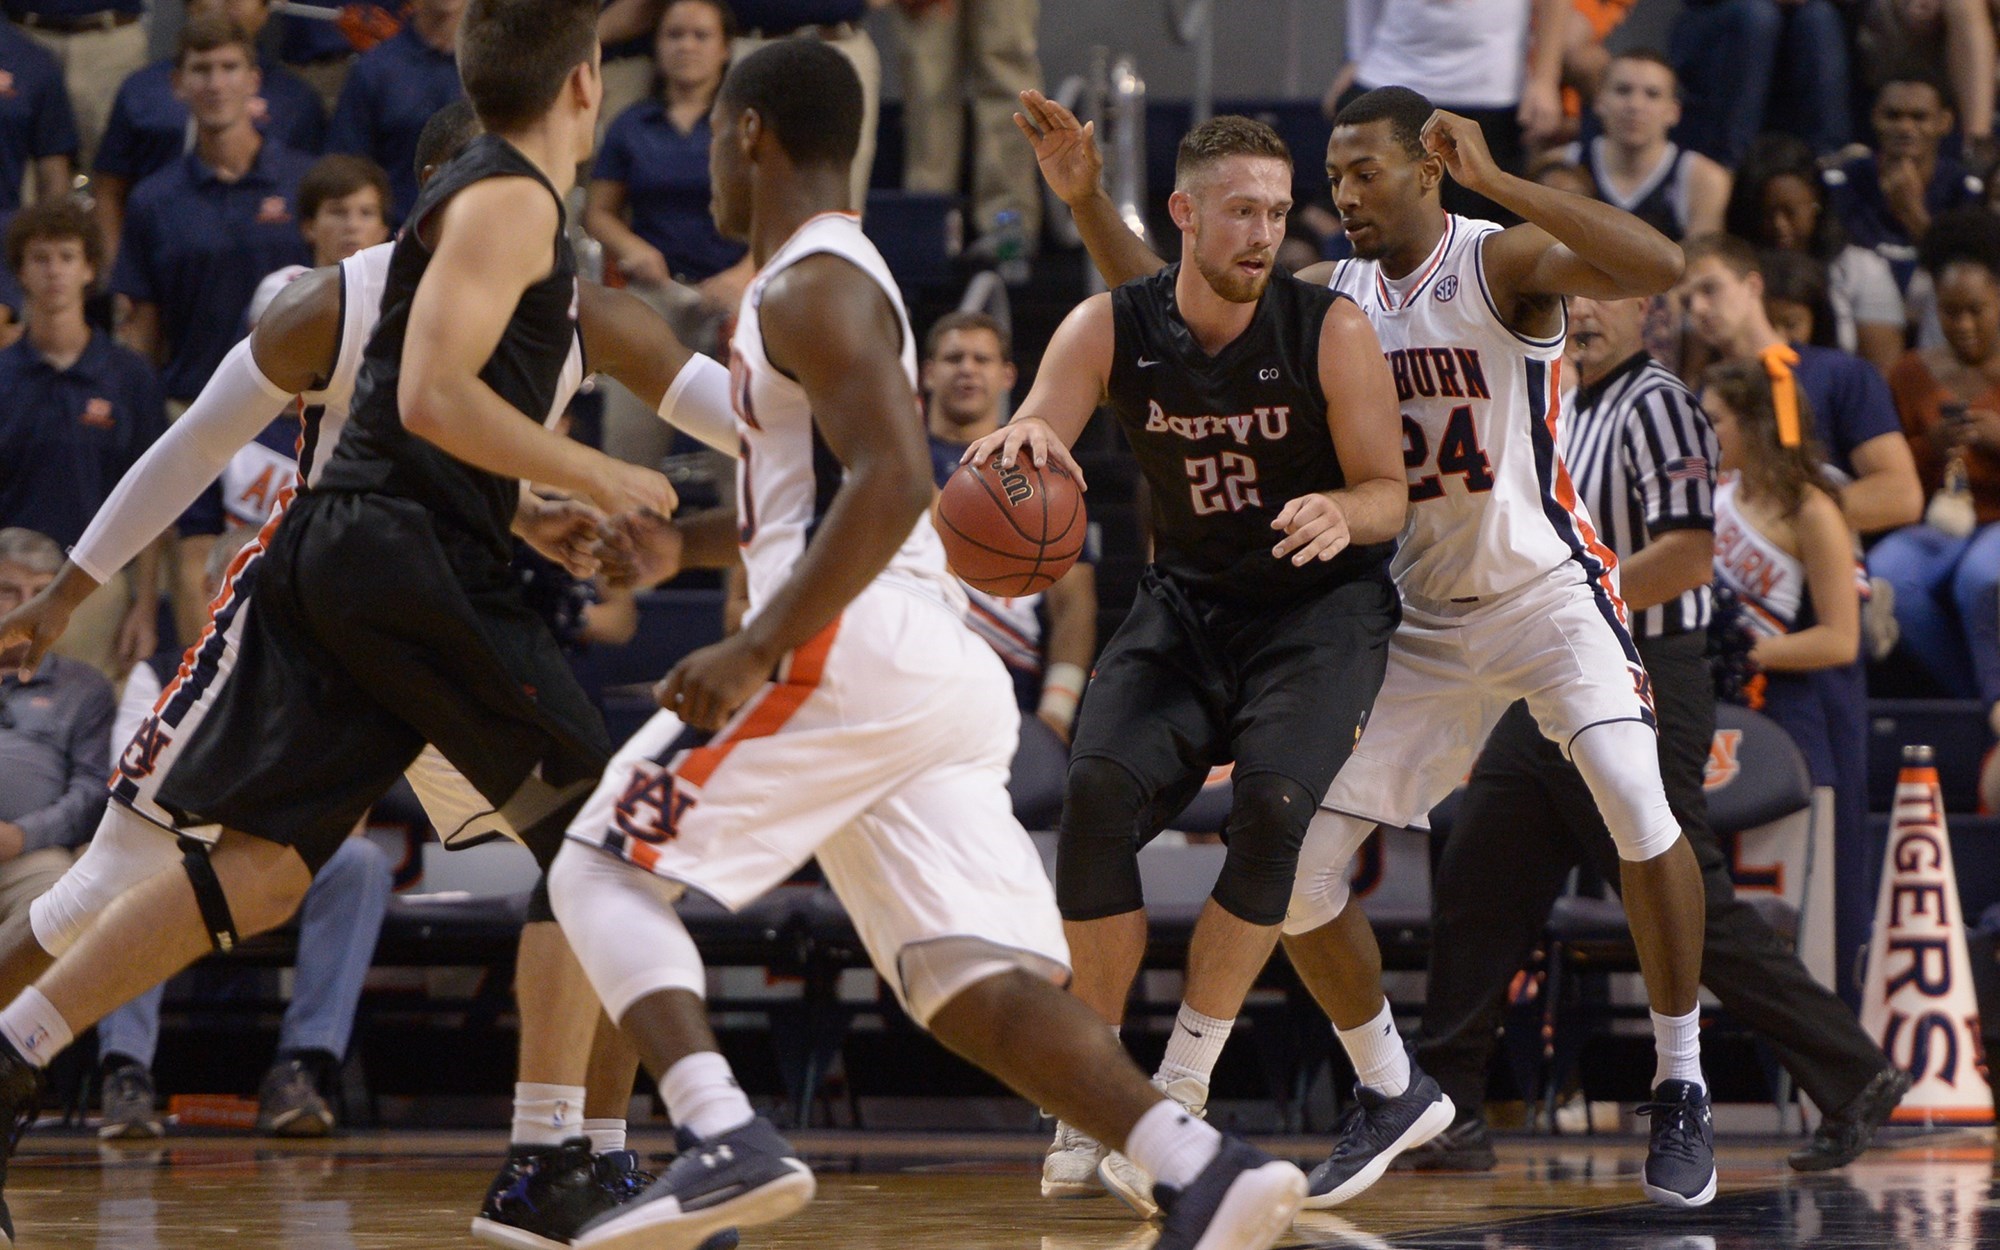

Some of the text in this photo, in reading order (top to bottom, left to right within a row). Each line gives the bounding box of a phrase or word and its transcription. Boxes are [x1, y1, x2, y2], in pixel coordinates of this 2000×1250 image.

[1435, 275, 1458, 302] SEC
[1258, 367, 1280, 381] CO
[1384, 346, 1492, 402] BURN
[1183, 450, 1264, 518] 22
[1401, 403, 1496, 503] 24
[1713, 515, 1787, 599] BURN
[1882, 781, 1958, 1089] TIGERS
